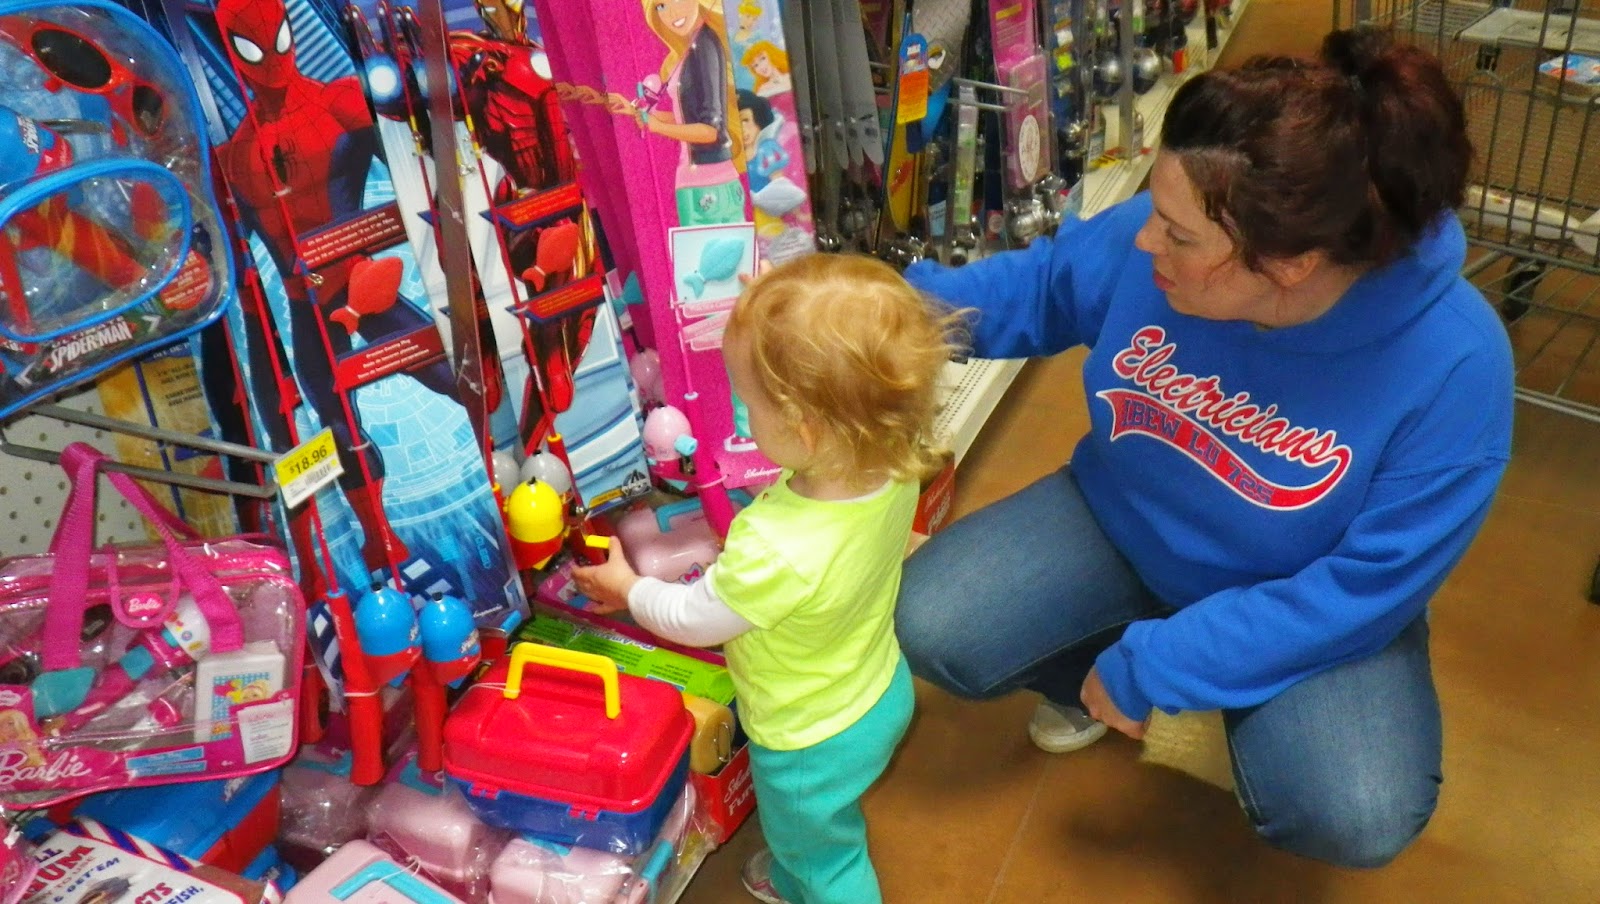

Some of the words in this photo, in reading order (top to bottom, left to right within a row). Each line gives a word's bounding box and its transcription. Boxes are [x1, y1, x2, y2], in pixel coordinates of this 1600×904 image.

[1112, 325, 1338, 467] Electricians
[289, 445, 328, 475] $18.96
[1121, 398, 1181, 440] IBEW
[1189, 430, 1222, 466] LU
[1226, 460, 1276, 506] 725
[0, 749, 92, 785] Barbie
